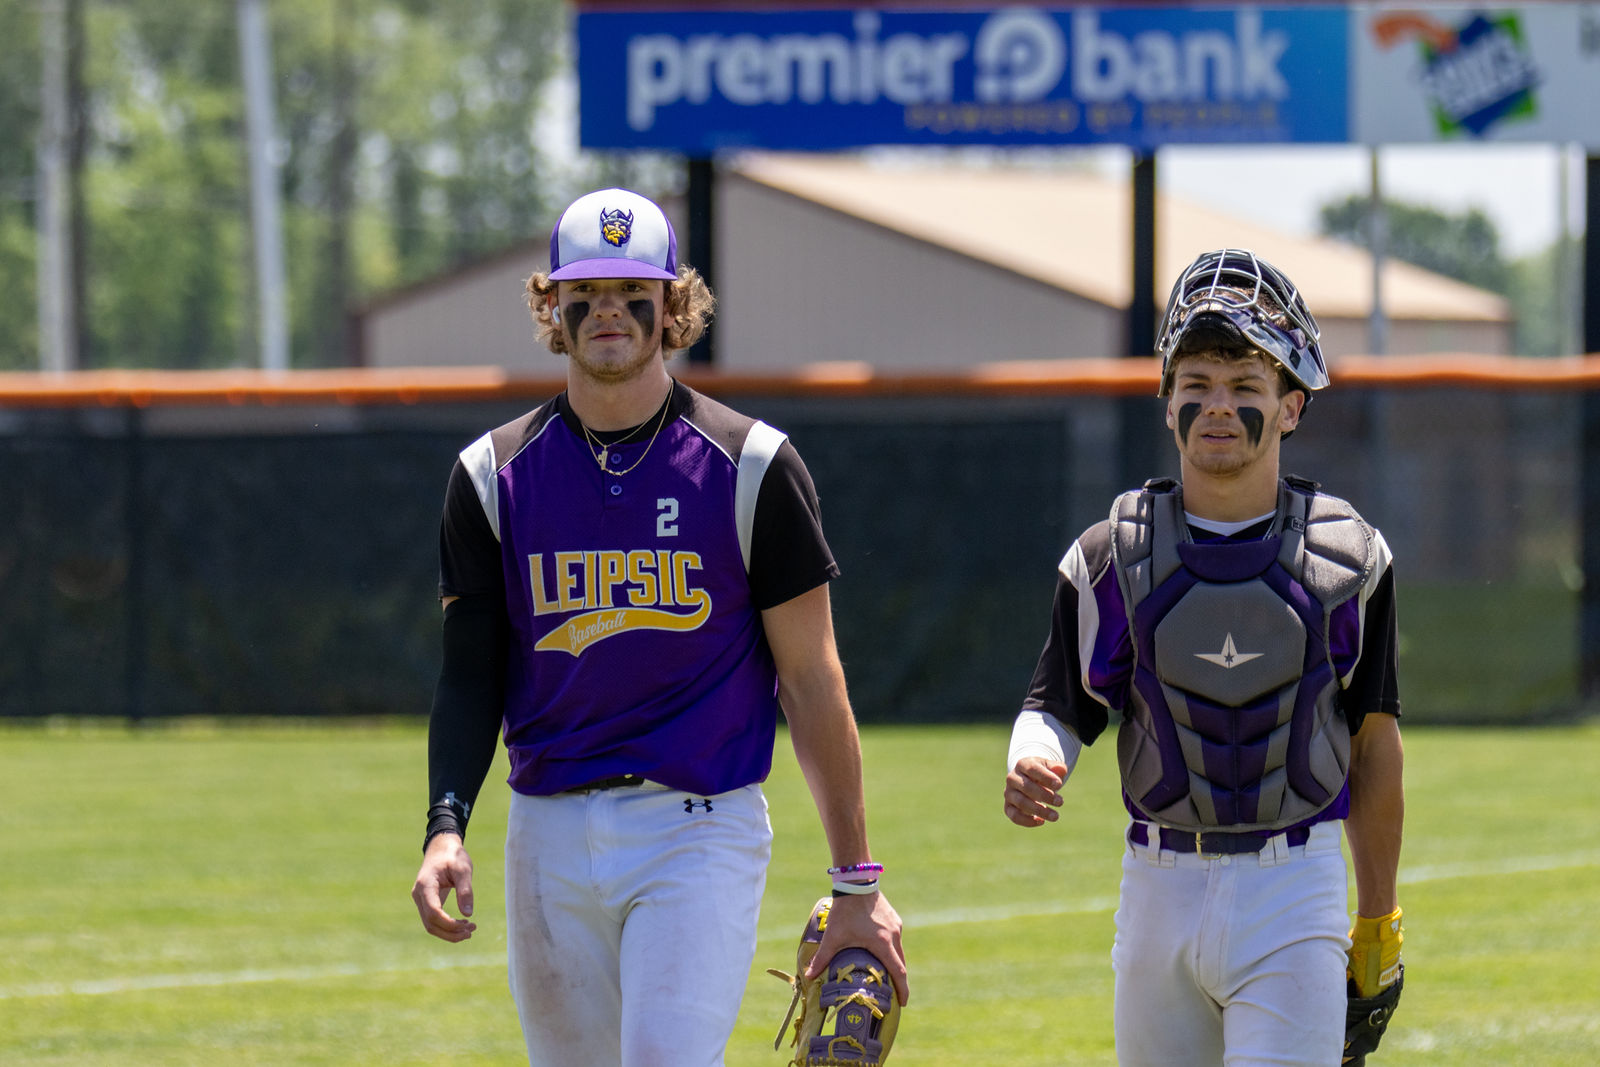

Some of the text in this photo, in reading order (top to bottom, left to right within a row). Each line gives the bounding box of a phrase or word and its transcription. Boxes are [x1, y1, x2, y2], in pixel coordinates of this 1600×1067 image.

[628, 12, 966, 130] premier
[1072, 9, 1288, 101] bank
[657, 498, 679, 537] 2
[528, 550, 704, 616] LEIPSIC
[568, 611, 627, 650] Baseball
